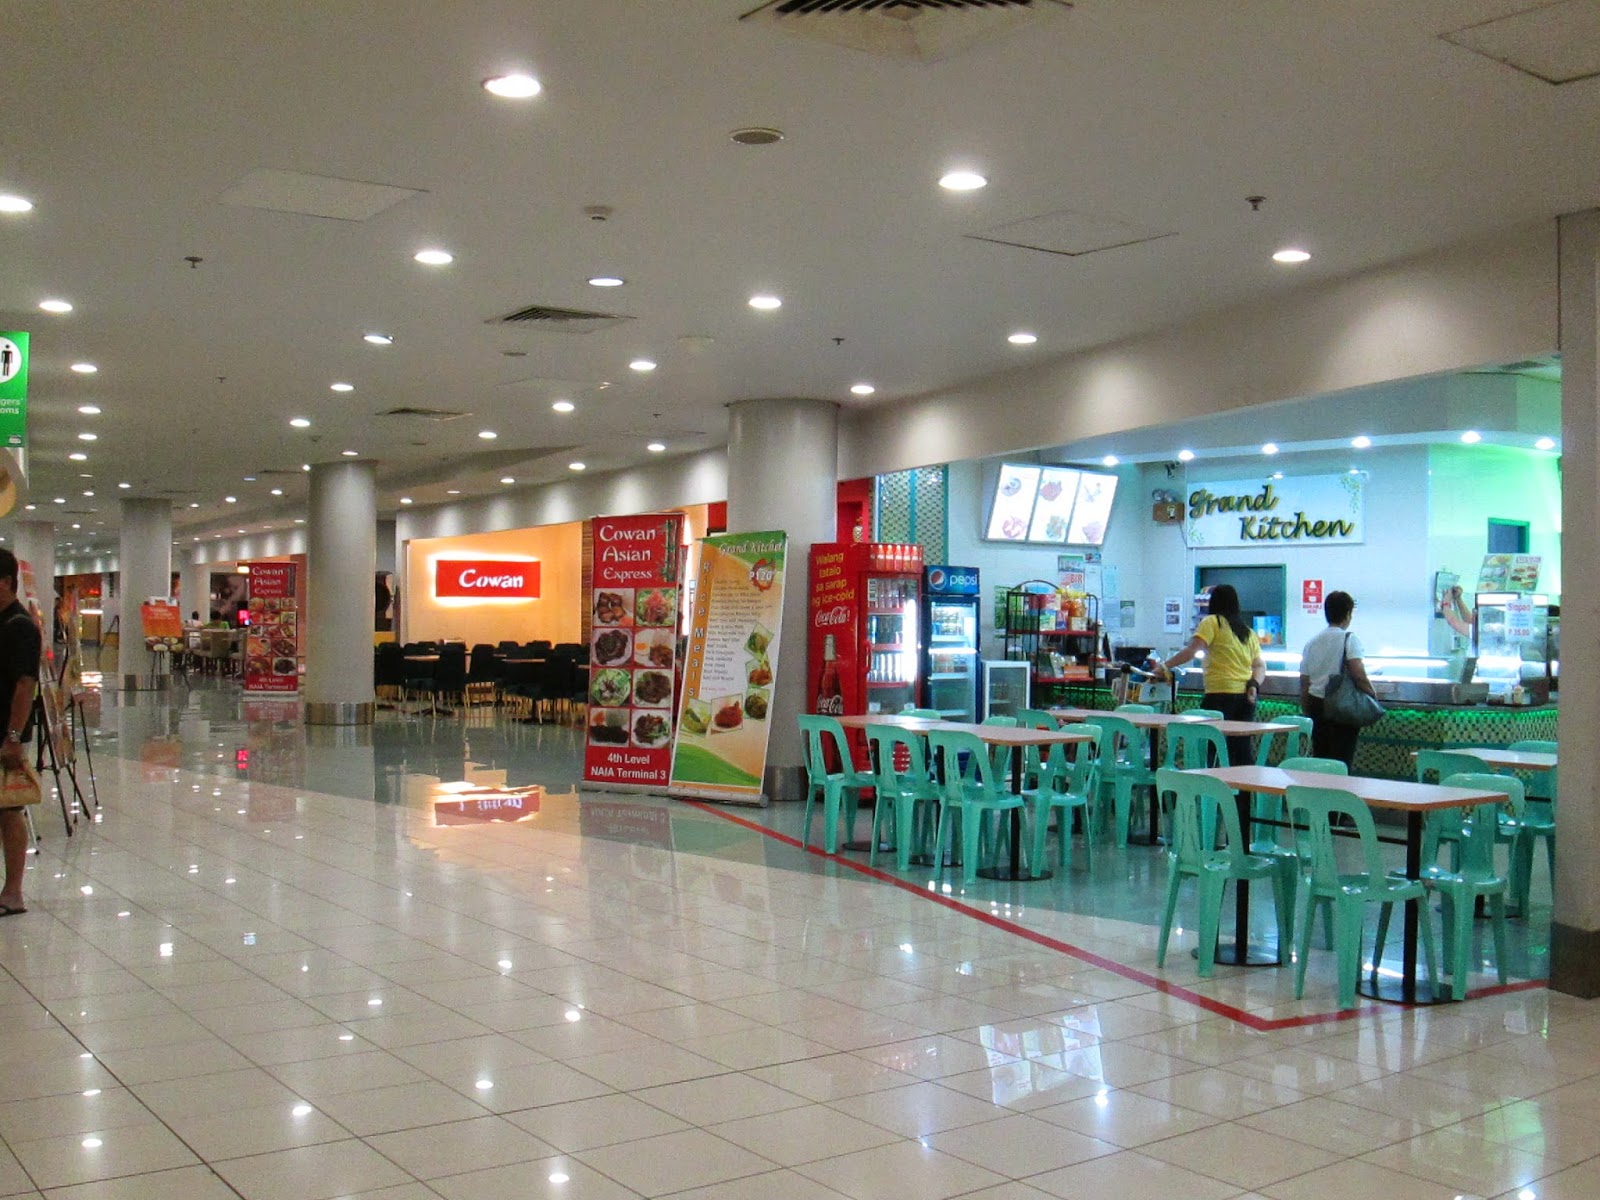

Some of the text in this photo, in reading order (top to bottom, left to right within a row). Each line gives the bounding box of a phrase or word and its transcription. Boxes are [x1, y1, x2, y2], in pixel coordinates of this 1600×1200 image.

[600, 525, 656, 541] Cowan
[1239, 511, 1354, 540] Kitchen
[602, 544, 651, 562] Asian
[252, 566, 284, 576] Cowan
[458, 568, 524, 588] Cowan
[603, 567, 652, 583] Express
[1070, 573, 1082, 584] BIR
[950, 574, 977, 587] pepsi
[608, 753, 650, 764] 4th Level
[591, 766, 666, 780] NAIA Terminal 3
